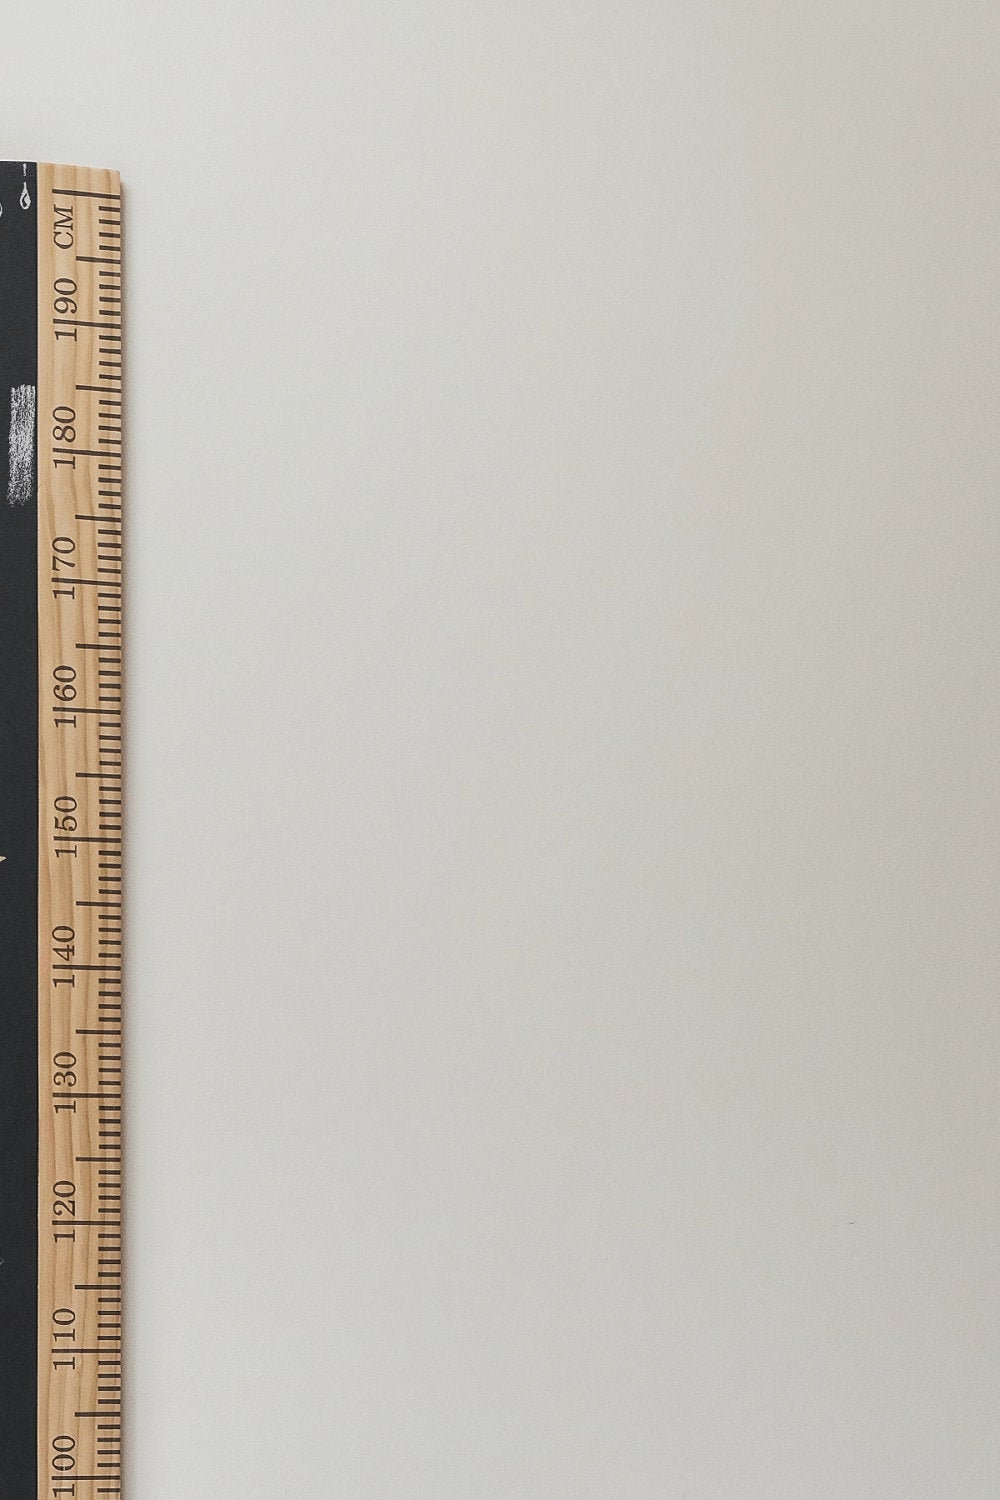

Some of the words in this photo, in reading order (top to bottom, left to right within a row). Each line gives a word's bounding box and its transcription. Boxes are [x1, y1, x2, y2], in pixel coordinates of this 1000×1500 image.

[53, 204, 74, 250] CM
[53, 277, 78, 342] 190
[52, 405, 76, 470] 180
[52, 535, 76, 600] 170
[53, 664, 77, 728] 160
[54, 795, 78, 858] 150
[52, 925, 76, 988] 140
[53, 1051, 77, 1114] 130
[52, 1179, 76, 1243] 120
[52, 1307, 76, 1371] 110
[52, 1434, 76, 1498] 100
